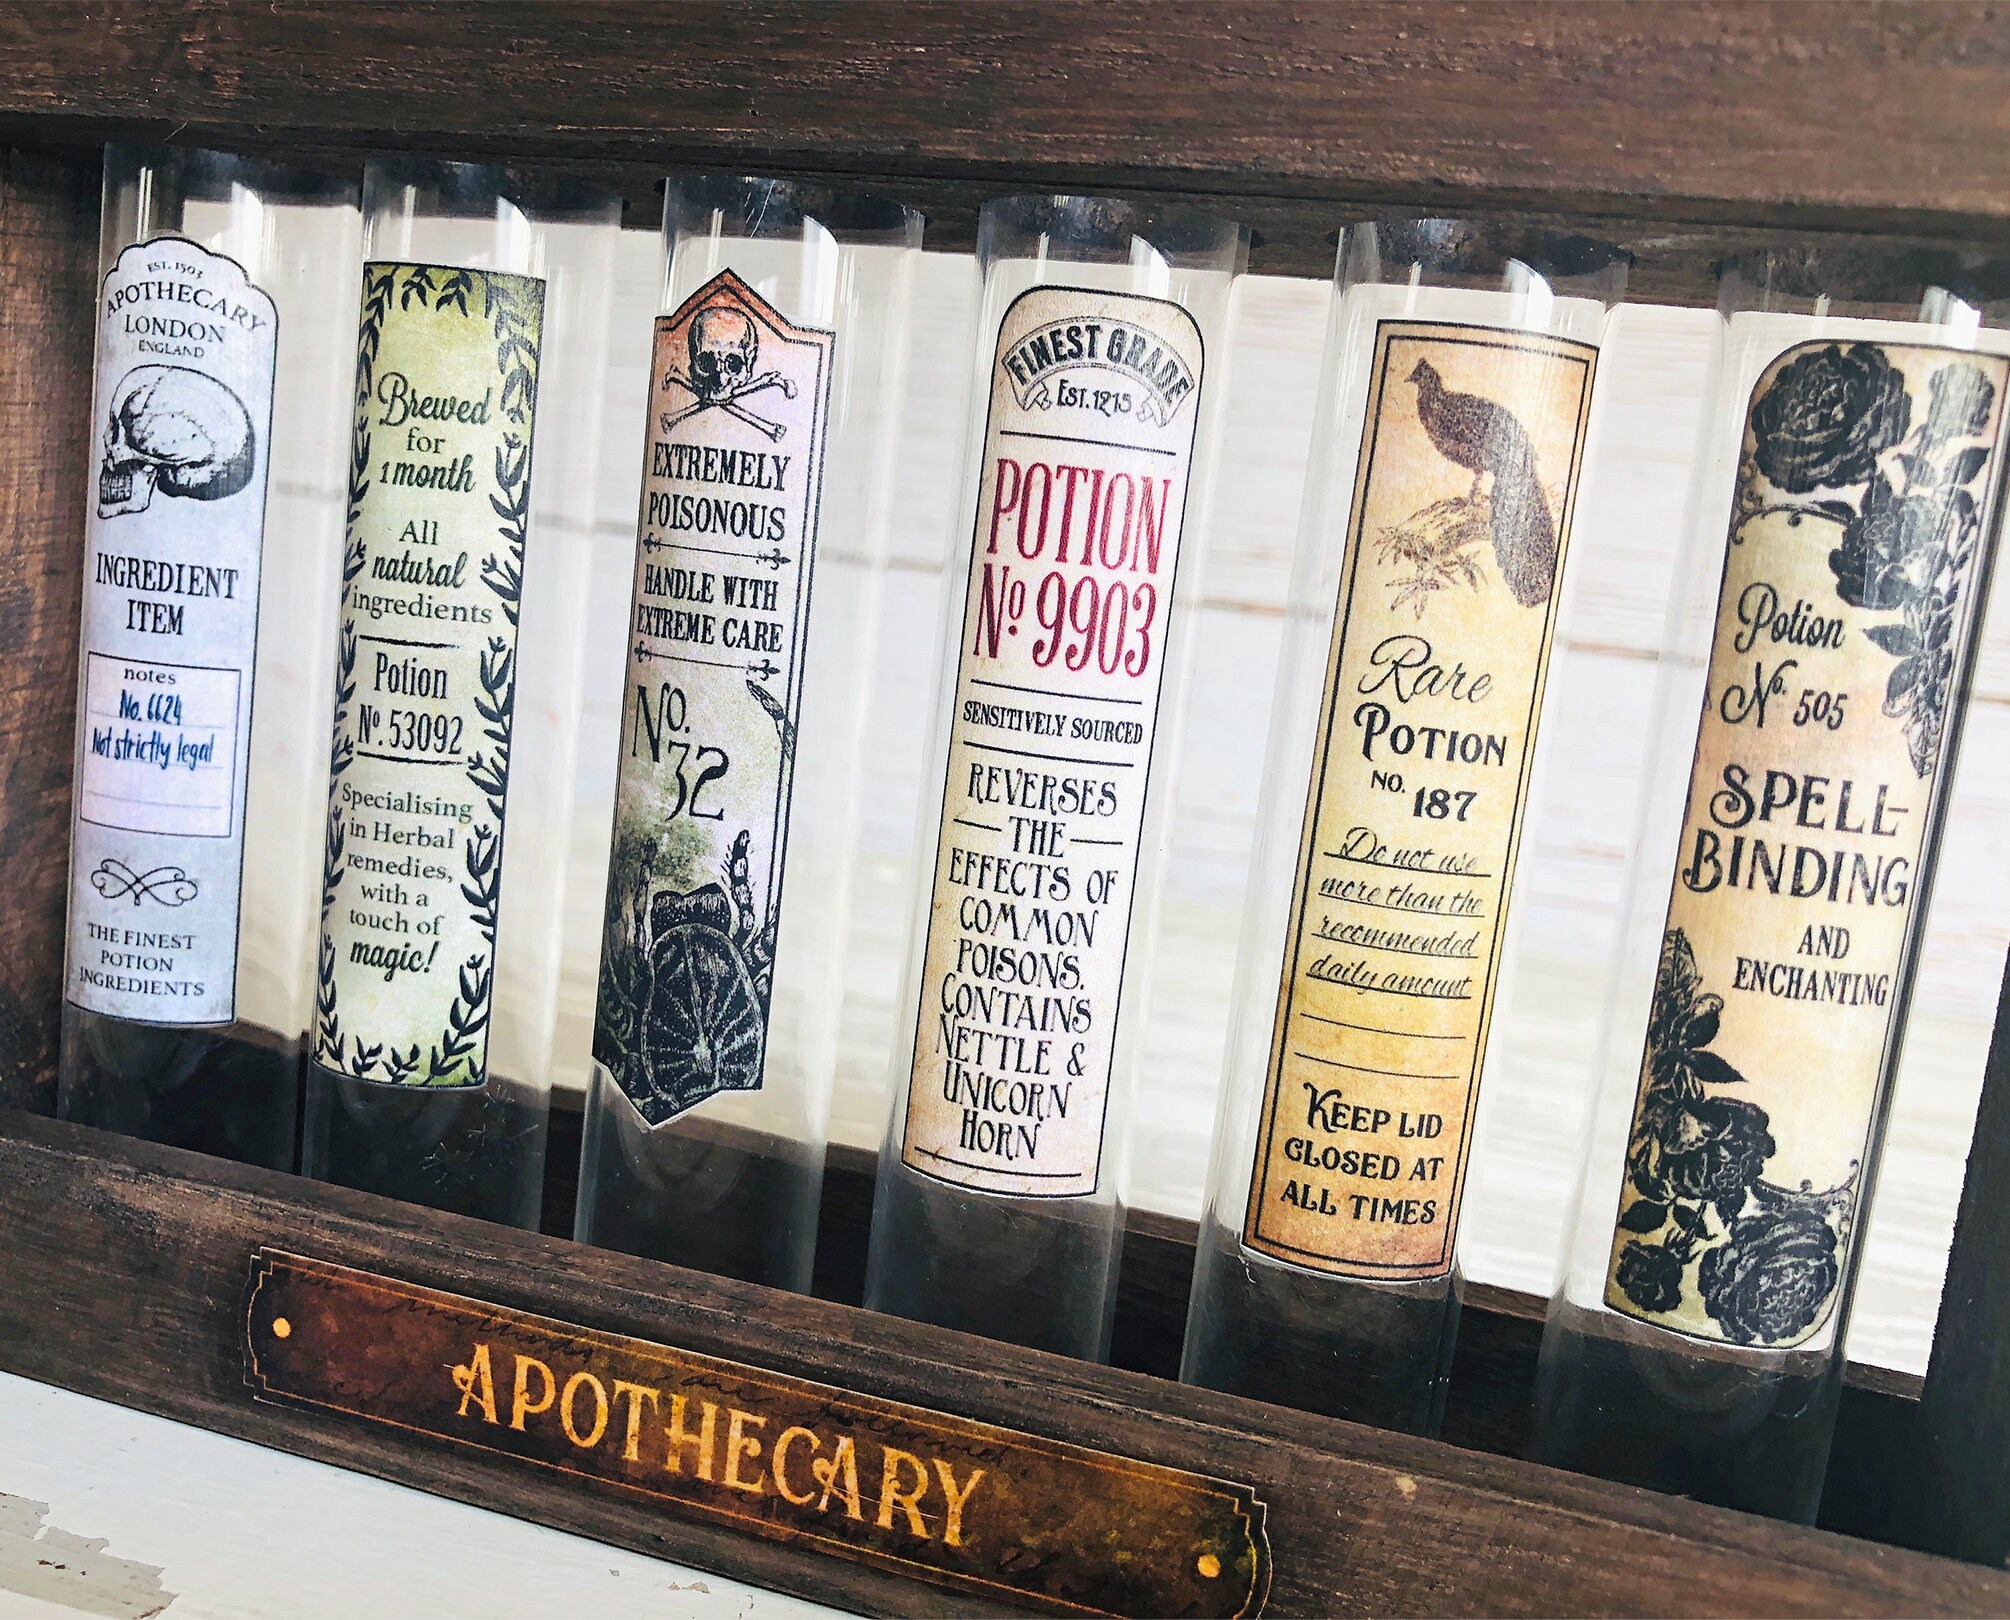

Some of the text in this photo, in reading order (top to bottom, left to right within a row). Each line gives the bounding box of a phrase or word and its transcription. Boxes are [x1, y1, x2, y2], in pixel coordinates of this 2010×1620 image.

[107, 281, 267, 332] APOTHECARY
[125, 314, 226, 343] LONDON
[138, 340, 205, 358] ENGLAND
[1007, 324, 1190, 408] FINEST GRADE
[377, 371, 493, 427] Brewed
[406, 426, 446, 454] for
[379, 453, 476, 494] 1 month
[652, 442, 791, 491] EXTREMELY
[399, 520, 438, 546] All
[647, 491, 786, 542] POISONOUS
[987, 458, 1171, 574] POTION
[96, 553, 239, 599] INGREDIENT
[372, 549, 468, 590] natural
[644, 563, 779, 611] HANDLE WITH
[126, 599, 185, 635] ITEM
[353, 585, 492, 624] ingredients
[1032, 571, 1157, 678] 9903
[1734, 581, 1846, 655] Potion
[636, 603, 783, 653] EXTREME CARE
[124, 667, 177, 685] notes
[374, 652, 448, 700] Potion
[1357, 634, 1494, 704] Rare
[119, 689, 182, 725] No. 6624
[963, 700, 1143, 745] SENSITIVELY SOURCED
[1793, 688, 1848, 731] 505
[92, 726, 215, 771] Not strictly legal
[342, 783, 474, 824] Specialising
[967, 763, 1118, 817] REVERSES
[1412, 786, 1477, 822] 187
[349, 817, 455, 850] in Herbal
[1008, 815, 1067, 858] THE
[1337, 826, 1478, 873] Do not use
[347, 853, 453, 883] remedies,
[949, 847, 1119, 905] EFFECTS OF
[1682, 827, 1910, 908] BINDING
[361, 884, 428, 907] with a
[1321, 877, 1483, 913] more than the
[88, 922, 196, 951] THE FINEST
[349, 910, 445, 936] touch of
[960, 895, 1099, 948] COMMON
[1320, 915, 1480, 956] recommended
[1797, 924, 1850, 961] AND
[79, 966, 205, 997] INGREDIENTS
[101, 949, 173, 972] POTION
[349, 940, 440, 982] magic!
[957, 938, 1085, 991] POISONS.
[1309, 954, 1473, 997] daily amount
[1733, 956, 1889, 1008] ENCHANTING
[941, 973, 1092, 1034] CONTAINS
[936, 1012, 1088, 1077] NETTLE &
[943, 1060, 1072, 1121] UNICORN
[959, 1108, 1042, 1161] HORN
[1400, 1112, 1443, 1138] LID
[1284, 1137, 1444, 1182] CLOSED AT
[1280, 1179, 1437, 1225] ALL TIMES
[450, 1341, 988, 1549] APOTHECARY
